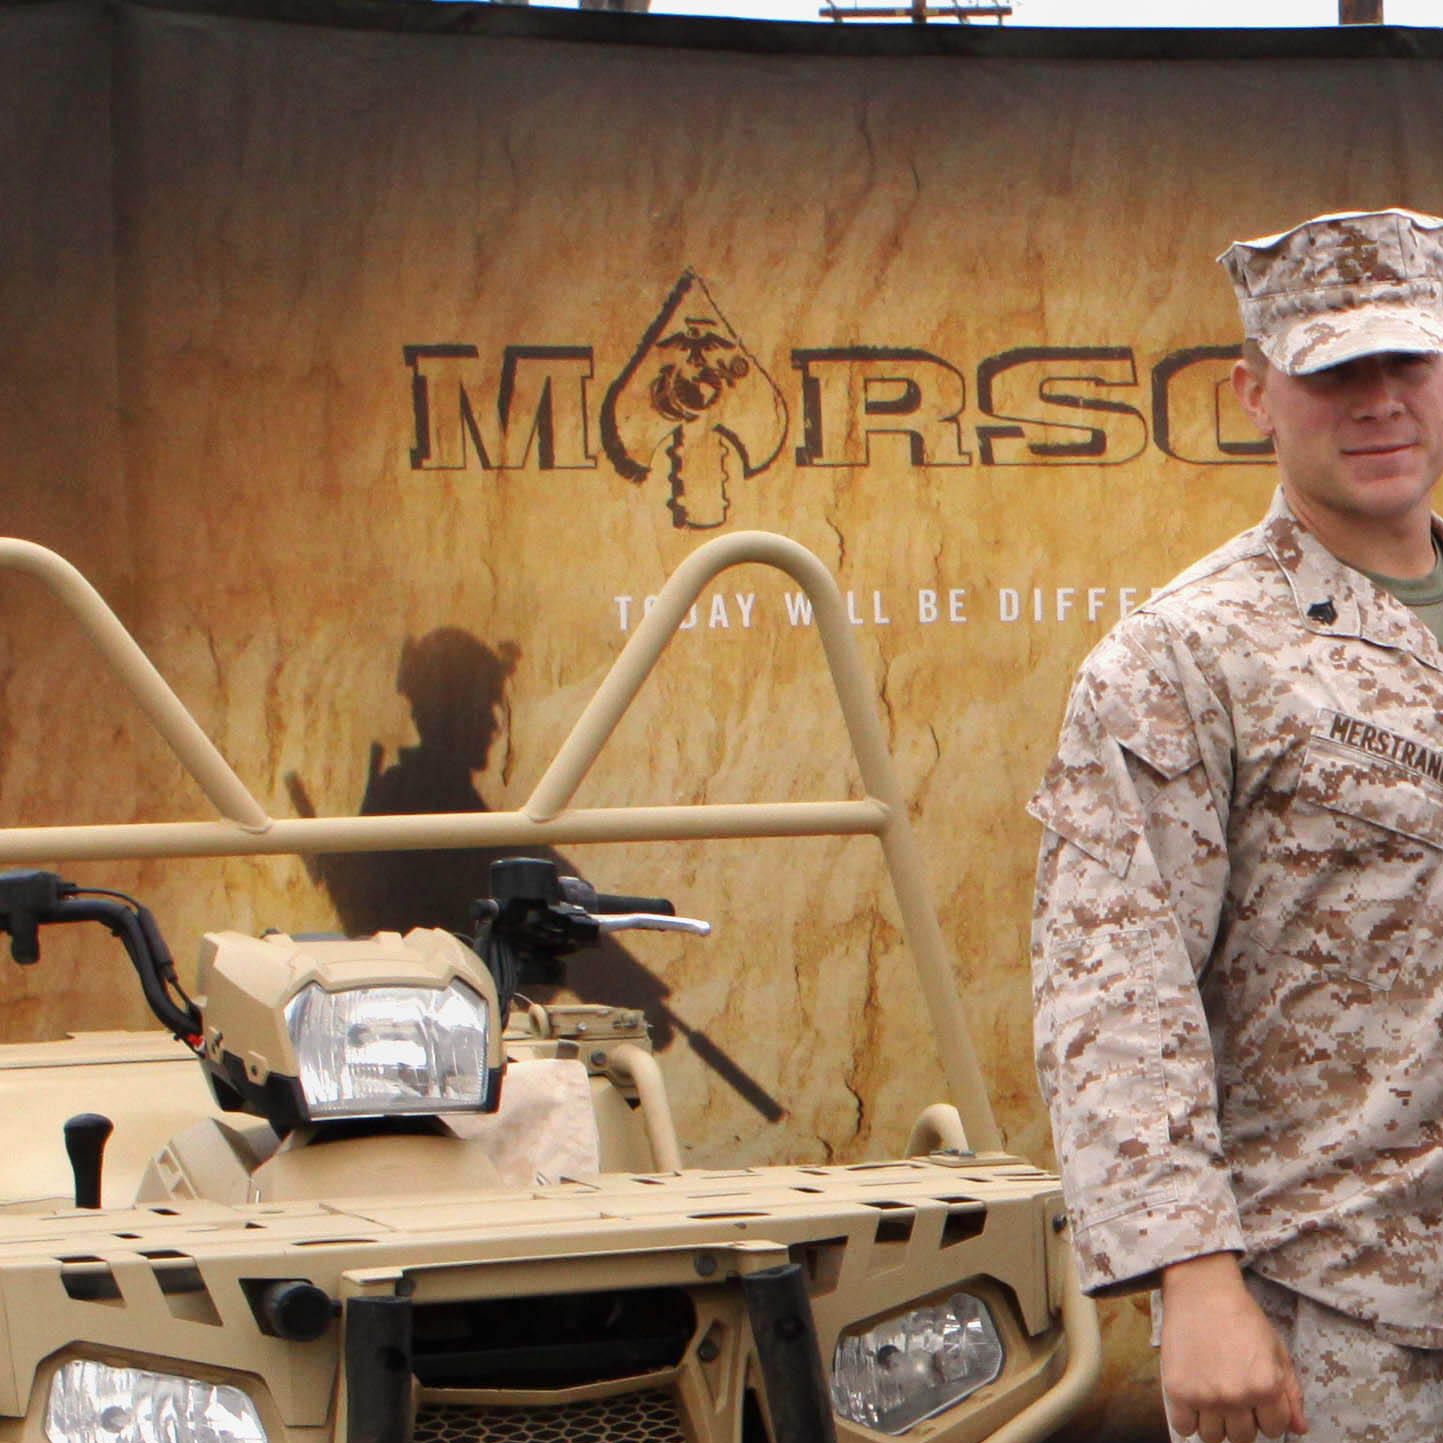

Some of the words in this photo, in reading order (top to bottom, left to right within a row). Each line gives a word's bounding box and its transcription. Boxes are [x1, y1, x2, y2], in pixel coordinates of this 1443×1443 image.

[614, 592, 755, 631] TAY
[785, 589, 891, 627] WLL
[918, 588, 968, 624] BE
[1000, 587, 1160, 623] DIFFE
